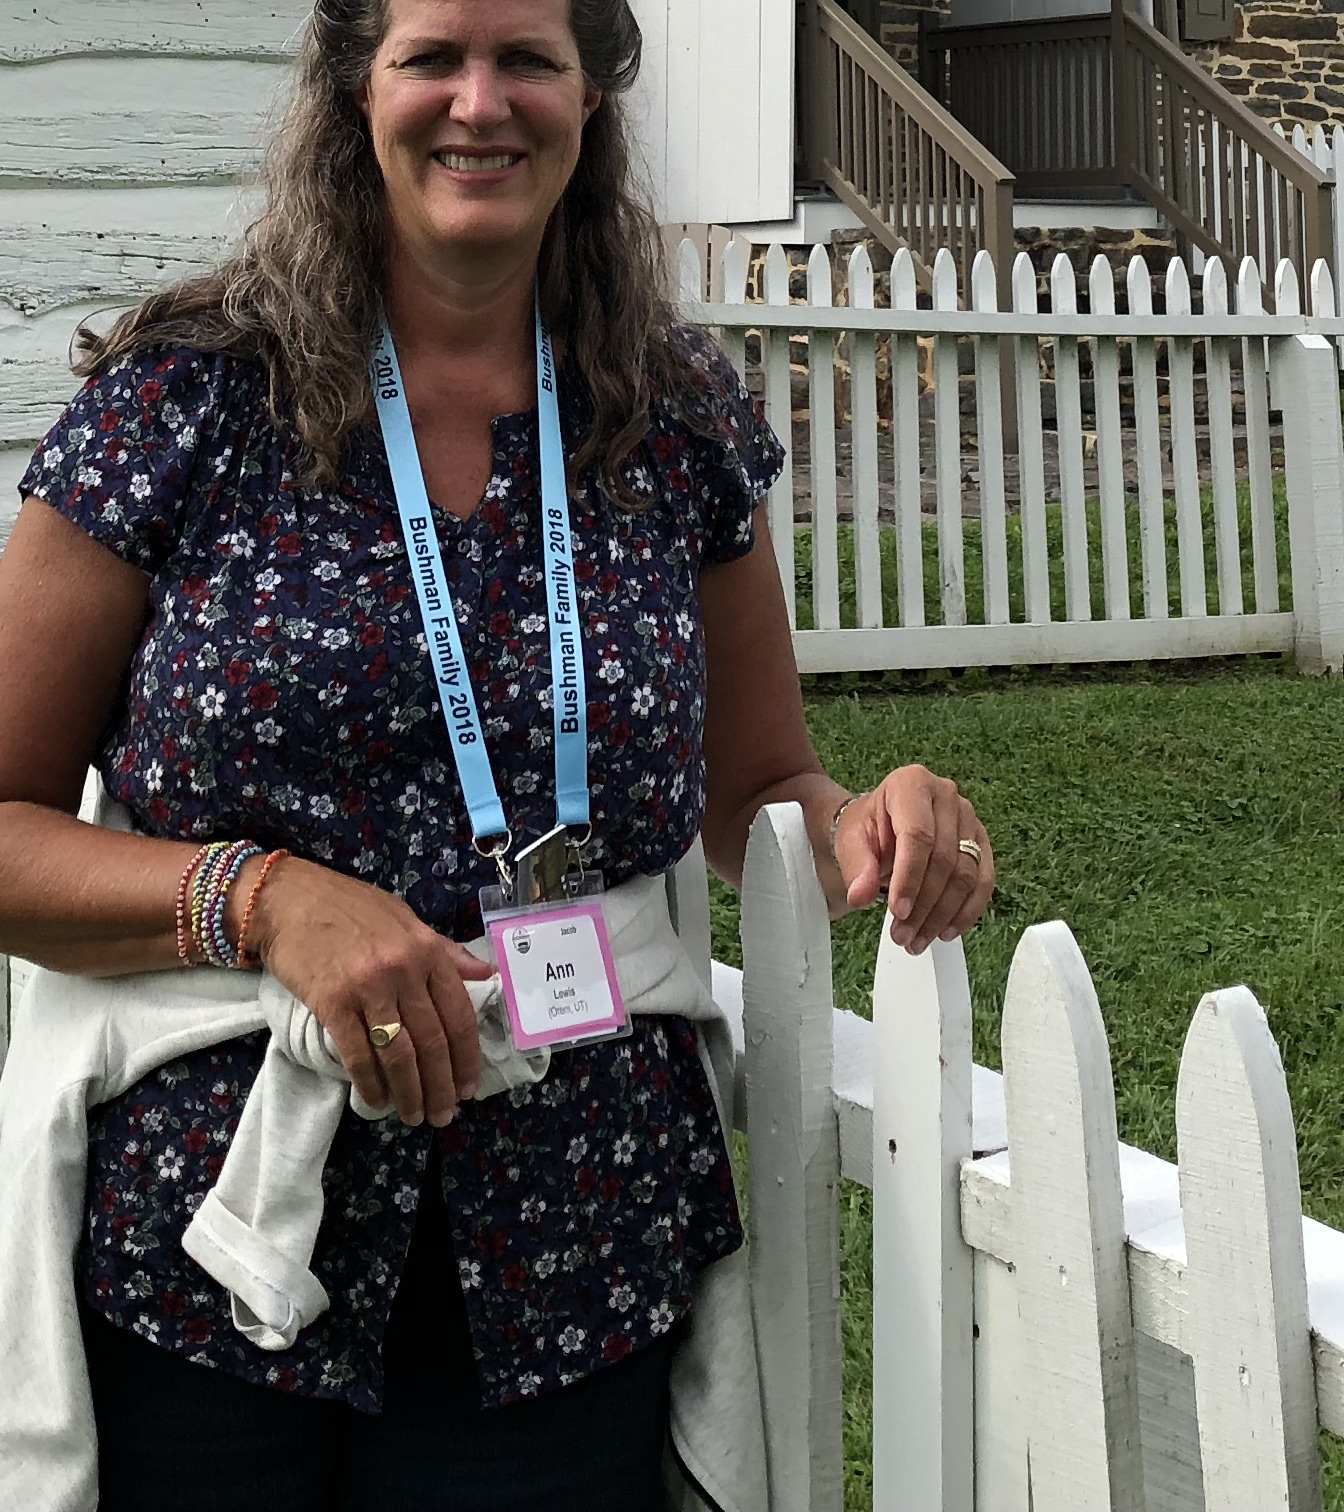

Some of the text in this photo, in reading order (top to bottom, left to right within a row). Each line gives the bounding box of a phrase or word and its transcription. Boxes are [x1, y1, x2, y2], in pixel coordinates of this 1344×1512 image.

[375, 355, 398, 400] 2018
[409, 516, 477, 746] Bushman Family 2018
[548, 508, 579, 734] Bushman Family 2018
[546, 962, 575, 982] Ann
